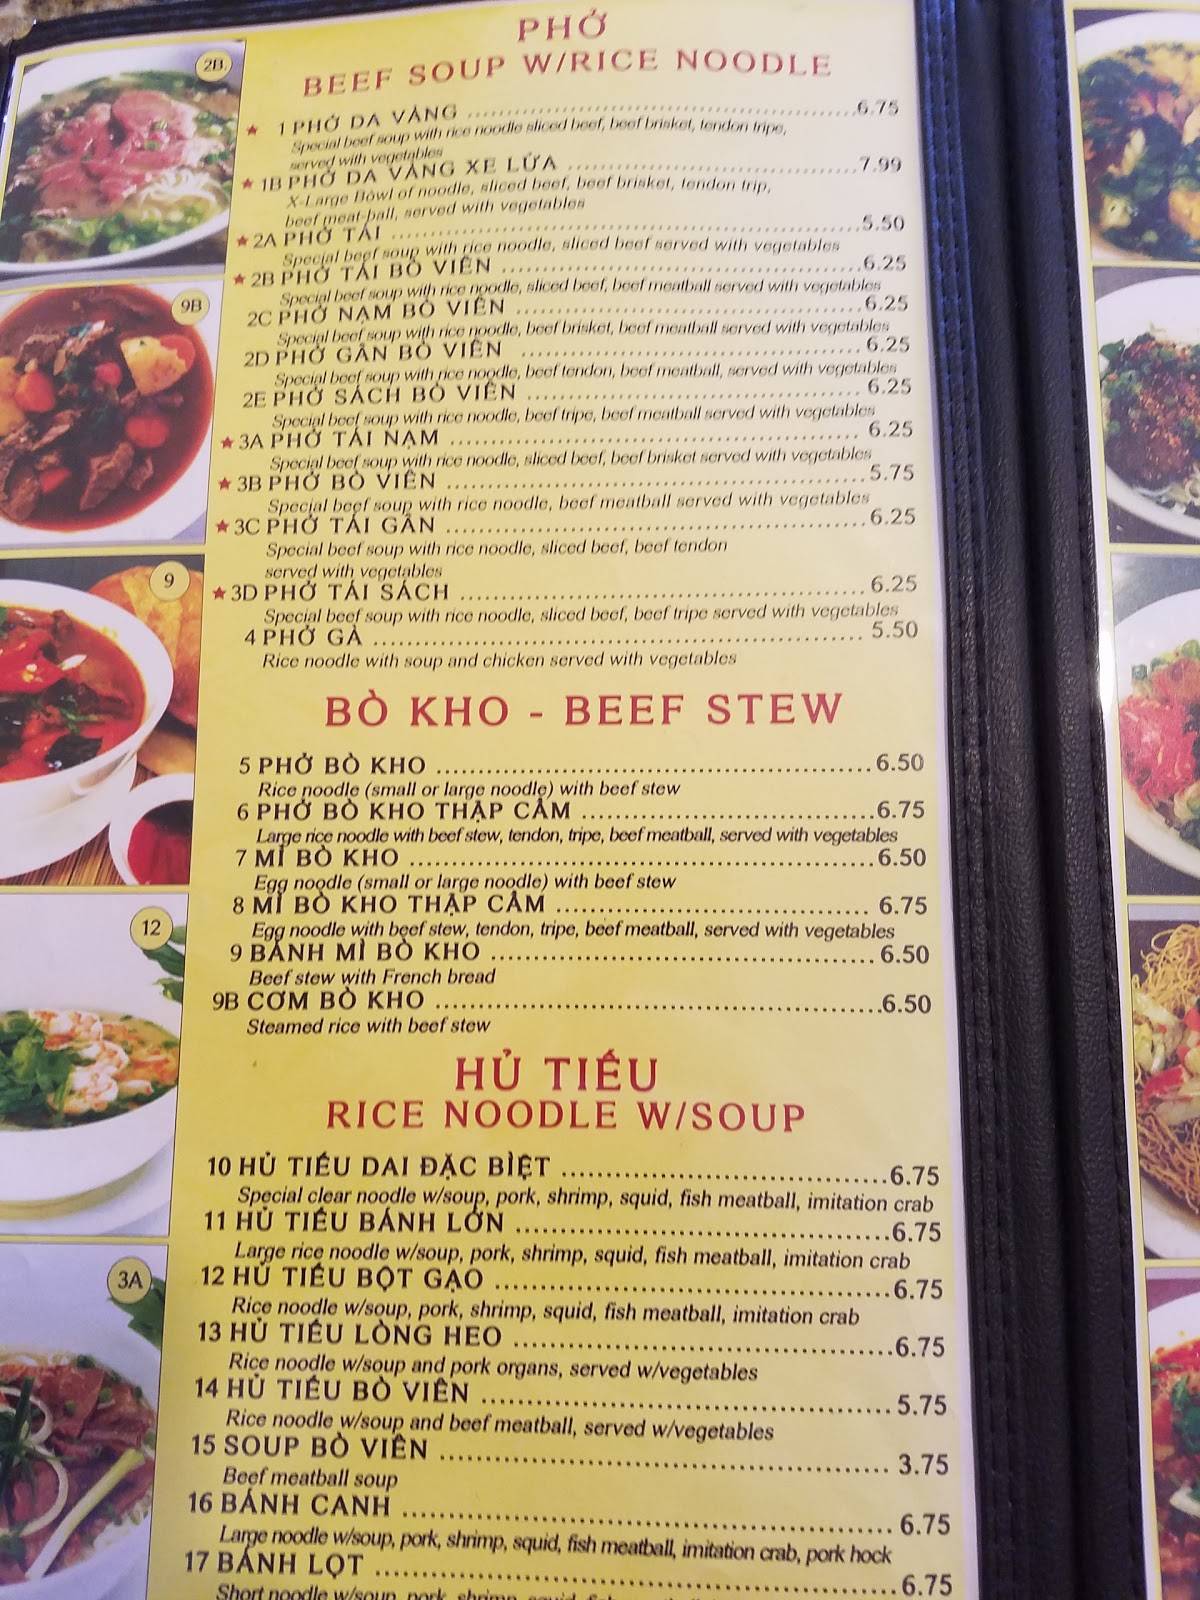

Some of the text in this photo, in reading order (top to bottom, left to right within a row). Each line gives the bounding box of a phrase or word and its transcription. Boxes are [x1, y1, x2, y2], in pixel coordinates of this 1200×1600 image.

[203, 59, 223, 72] 2B
[303, 48, 832, 97] BEEF SOUP W/RICE NOODLE
[350, 112, 380, 130] DA
[857, 99, 899, 116] 6.75
[859, 156, 902, 173] 7.99
[253, 232, 277, 249] 2A
[862, 215, 905, 232] 5.50
[282, 248, 340, 271] Special
[344, 246, 380, 263] beef
[382, 246, 420, 263] soup
[425, 240, 457, 256] with
[462, 239, 493, 255] rice
[561, 235, 610, 251] sliced
[614, 234, 653, 251] beef
[655, 236, 709, 251] served
[714, 237, 747, 252] with
[755, 237, 840, 255] vegetables
[181, 299, 202, 313] 9B
[247, 310, 272, 327] 2C
[865, 295, 908, 312] 6.25
[237, 475, 262, 492] 3B
[870, 464, 914, 481] 5.75
[268, 488, 870, 519] Special beef soup with rice noodle, beef meatball served with vegetables
[164, 573, 174, 589] 9
[265, 561, 442, 583] served with vegetables
[244, 629, 256, 646] 4
[871, 621, 918, 638] 5.50
[263, 649, 737, 672] Rice noodle with soup and chicken served with vegetables
[410, 696, 509, 727] KHO
[565, 694, 684, 726] BEEF
[707, 692, 843, 725] STEW
[239, 757, 250, 775] 5
[370, 757, 426, 776] KHO
[876, 753, 924, 772] 6.50
[257, 779, 681, 801] Rice noodle (small or large noodle) with beef stew
[142, 919, 161, 936] 12
[248, 967, 496, 987] Beef stew with French bread
[213, 991, 240, 1011] 9B
[368, 991, 424, 1010] KHO
[882, 995, 932, 1014] 6.50
[246, 1016, 491, 1035] Steamed rice with beef stew
[326, 1100, 805, 1132] RICE NOODLE W/SOUP
[208, 1155, 231, 1177] 10
[361, 1156, 408, 1178] DAI
[890, 1165, 940, 1186] 6.75
[238, 1185, 934, 1213] Special clear noodle w/soup, pork, shrimp, squid, fish meatball, imitation crab
[118, 1271, 143, 1288] 3A
[198, 1321, 221, 1343] 13
[444, 1324, 501, 1347] HEO
[895, 1336, 945, 1358] 6.75
[228, 1352, 758, 1383] Rice noodle w/soup and pork organs, served w/vegetables
[192, 1433, 215, 1456] 15
[224, 1434, 299, 1458] SOUP
[899, 1453, 949, 1475] 3.75
[223, 1466, 398, 1492] Beef meatball soup
[189, 1492, 212, 1514] 16
[310, 1494, 390, 1518] CANH
[900, 1513, 950, 1535] 6.75
[185, 1550, 209, 1573] 17
[902, 1574, 952, 1596] 6.75
